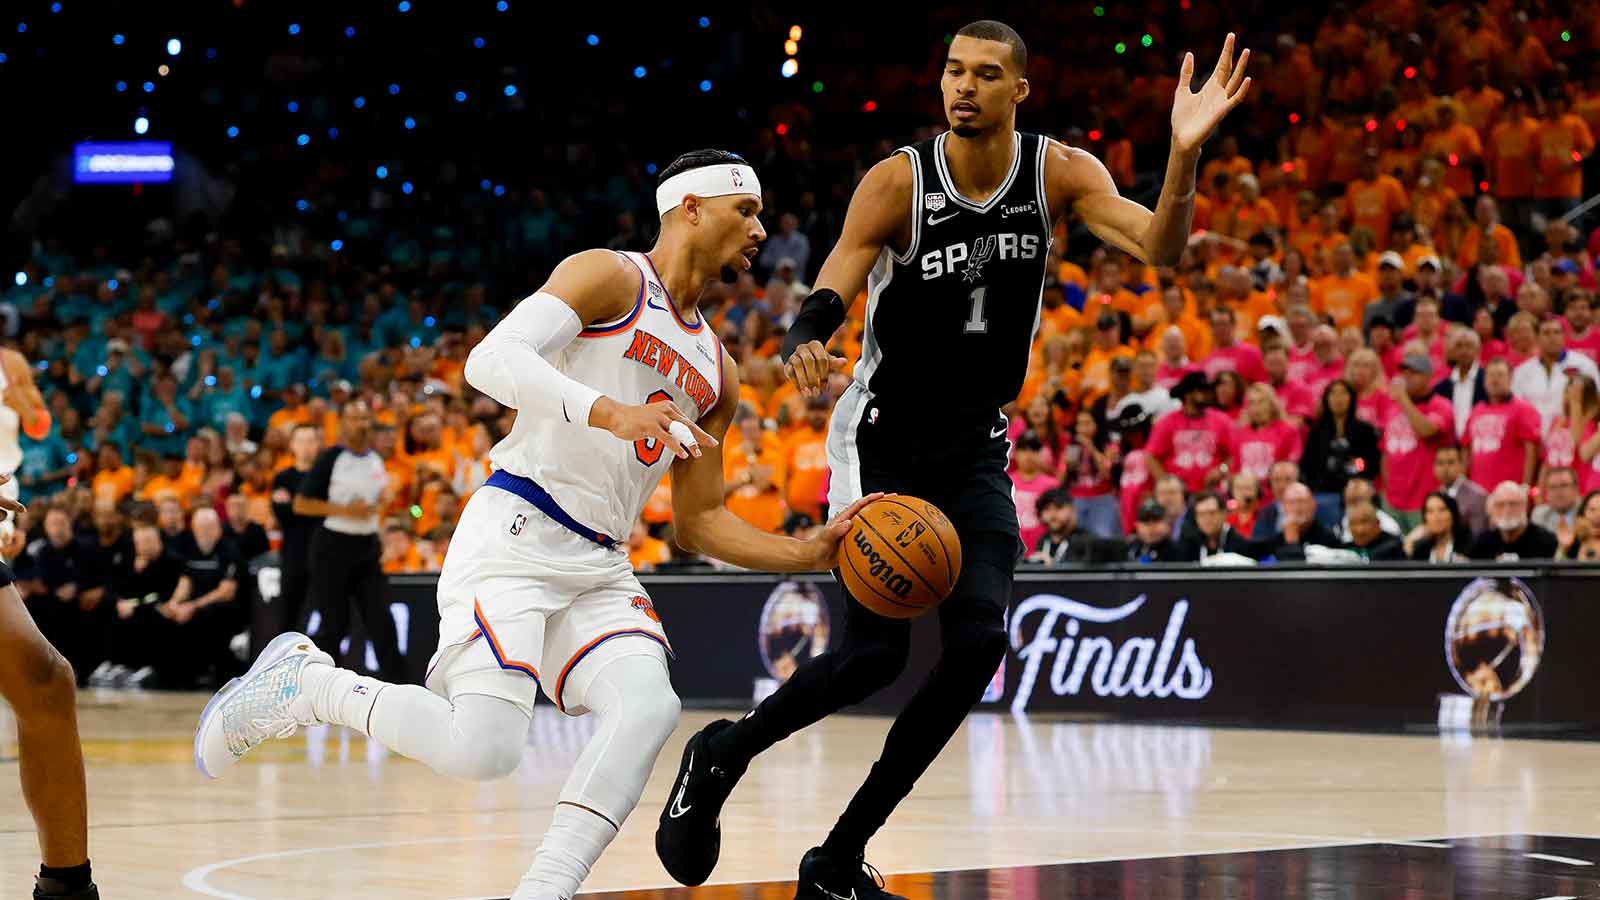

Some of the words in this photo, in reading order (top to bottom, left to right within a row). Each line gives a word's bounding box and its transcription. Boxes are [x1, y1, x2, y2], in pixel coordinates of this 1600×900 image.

[1004, 203, 1033, 215] LEDGER
[921, 233, 1039, 283] SPURS
[963, 286, 988, 333] 1
[622, 328, 677, 377] NEW
[674, 353, 717, 416] YORK
[1010, 594, 1213, 713] Finals
